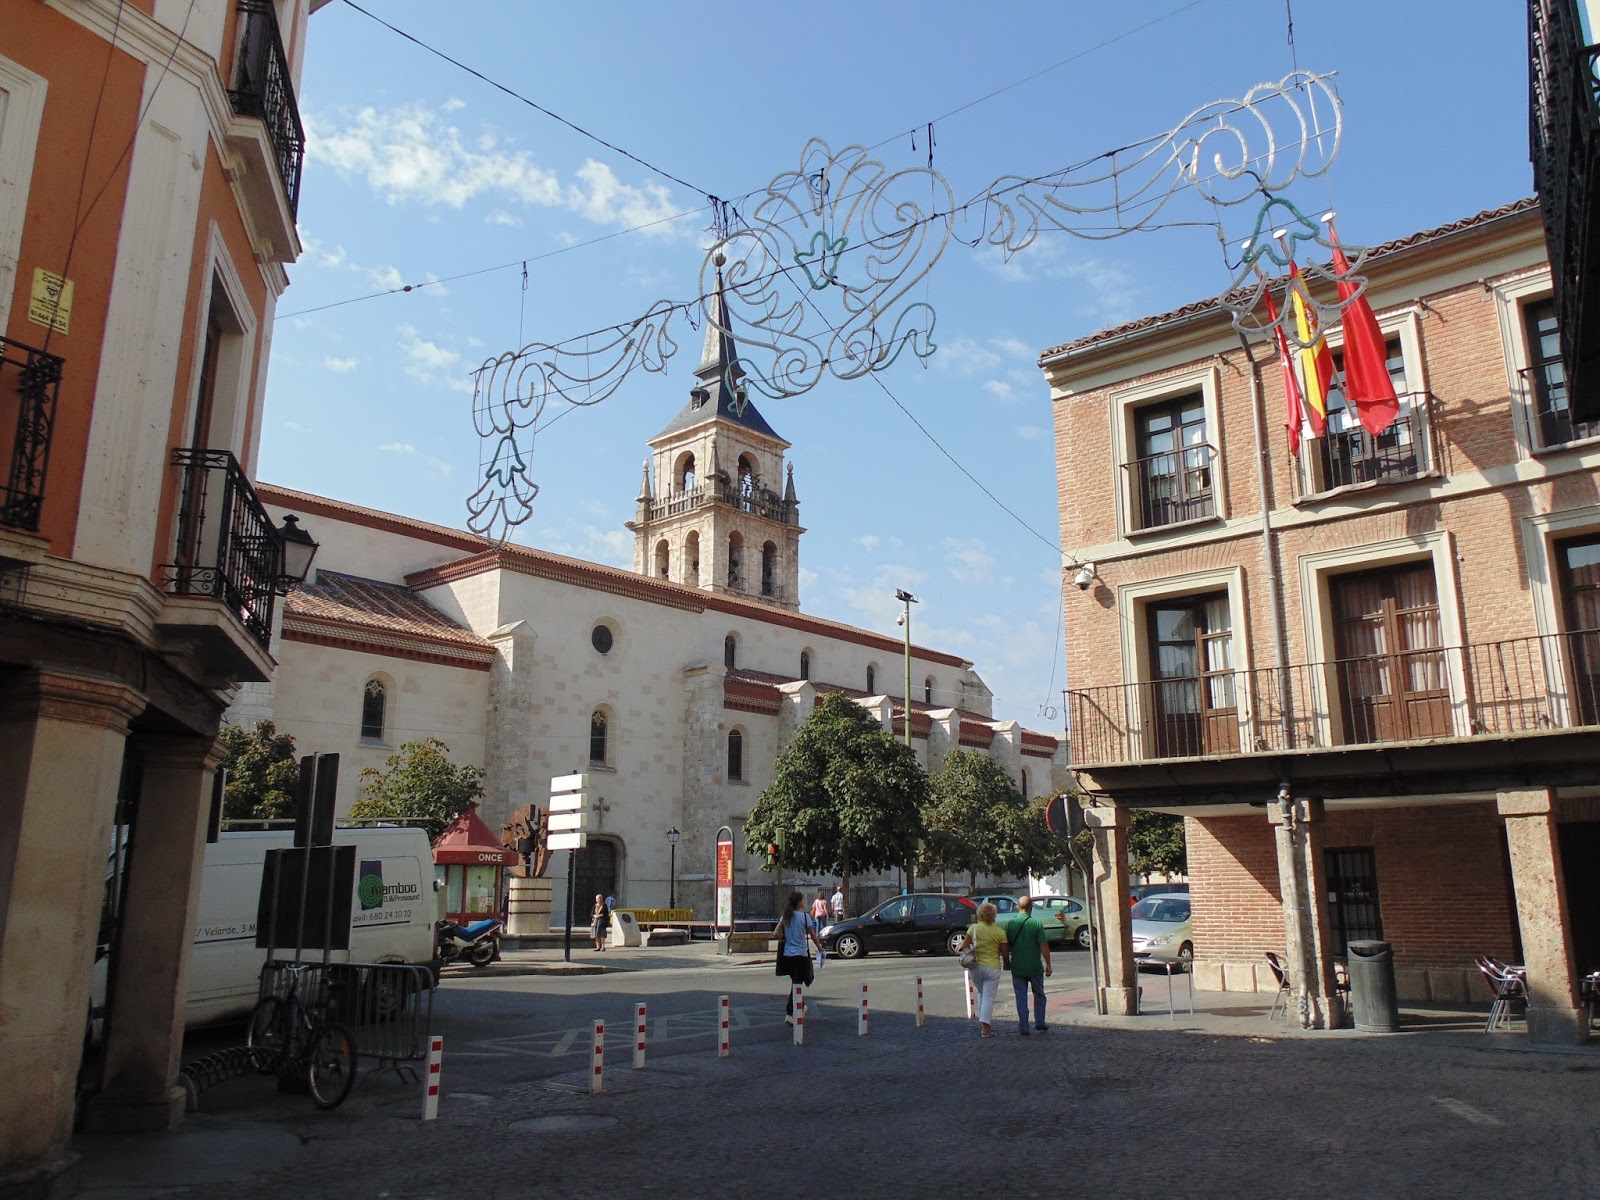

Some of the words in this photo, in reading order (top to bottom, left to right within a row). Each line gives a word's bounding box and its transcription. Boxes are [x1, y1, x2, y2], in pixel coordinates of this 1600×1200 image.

[478, 853, 503, 862] ONCE
[204, 925, 239, 936] Velarde,
[352, 913, 368, 923] ovil:
[369, 912, 383, 921] 680
[384, 911, 393, 920] 24
[395, 910, 403, 918] 10
[404, 909, 412, 918] 10
